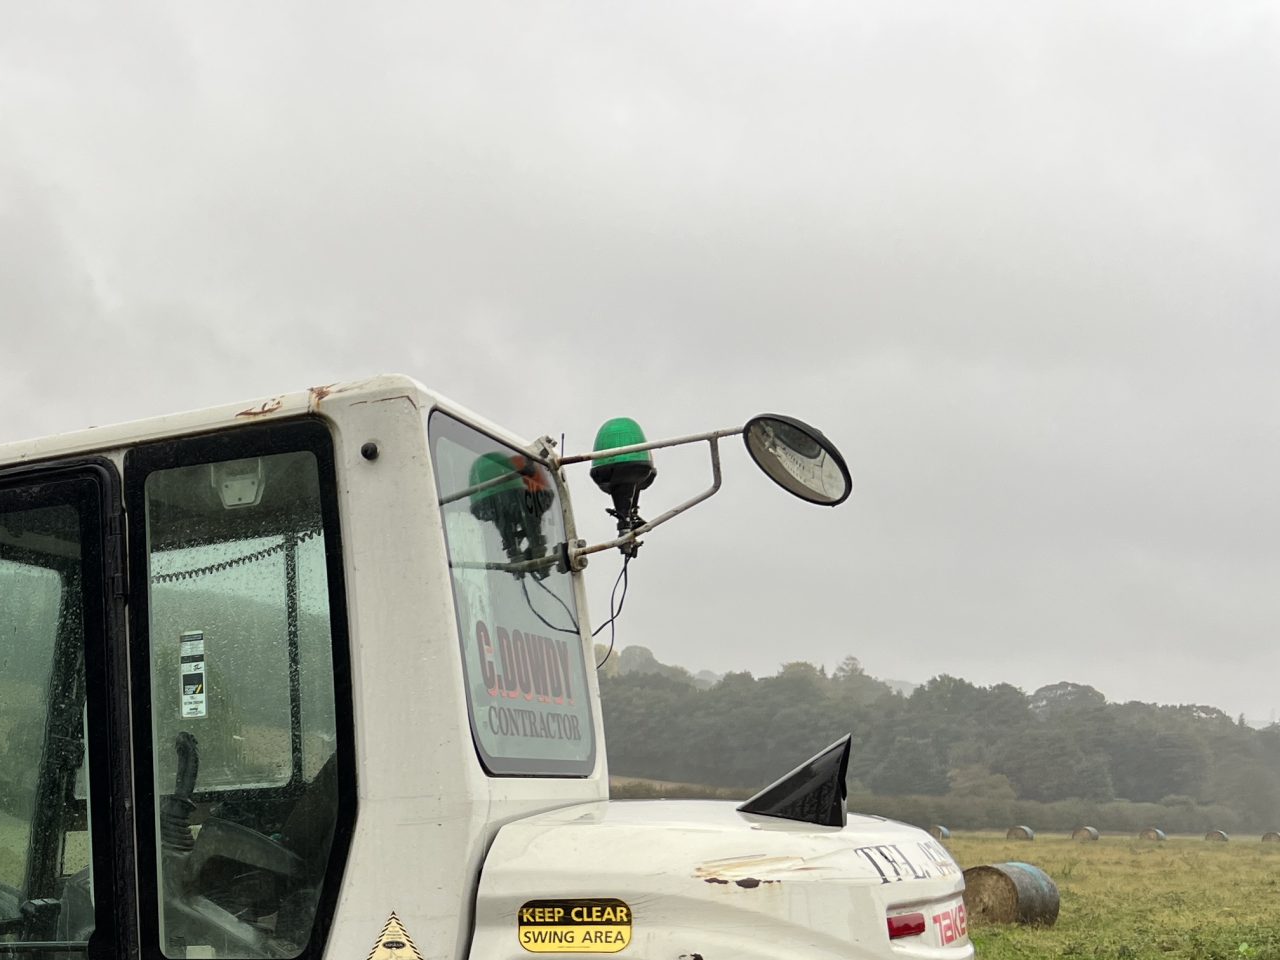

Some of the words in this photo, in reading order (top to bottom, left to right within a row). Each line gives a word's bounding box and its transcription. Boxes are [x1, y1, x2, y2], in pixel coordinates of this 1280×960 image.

[476, 620, 575, 705] C.DOWDY
[488, 705, 582, 740] CONTRACTOR
[522, 907, 564, 922] KEEP
[571, 906, 628, 922] CLEAR
[523, 930, 575, 944] SWING
[581, 930, 625, 944] AREA
